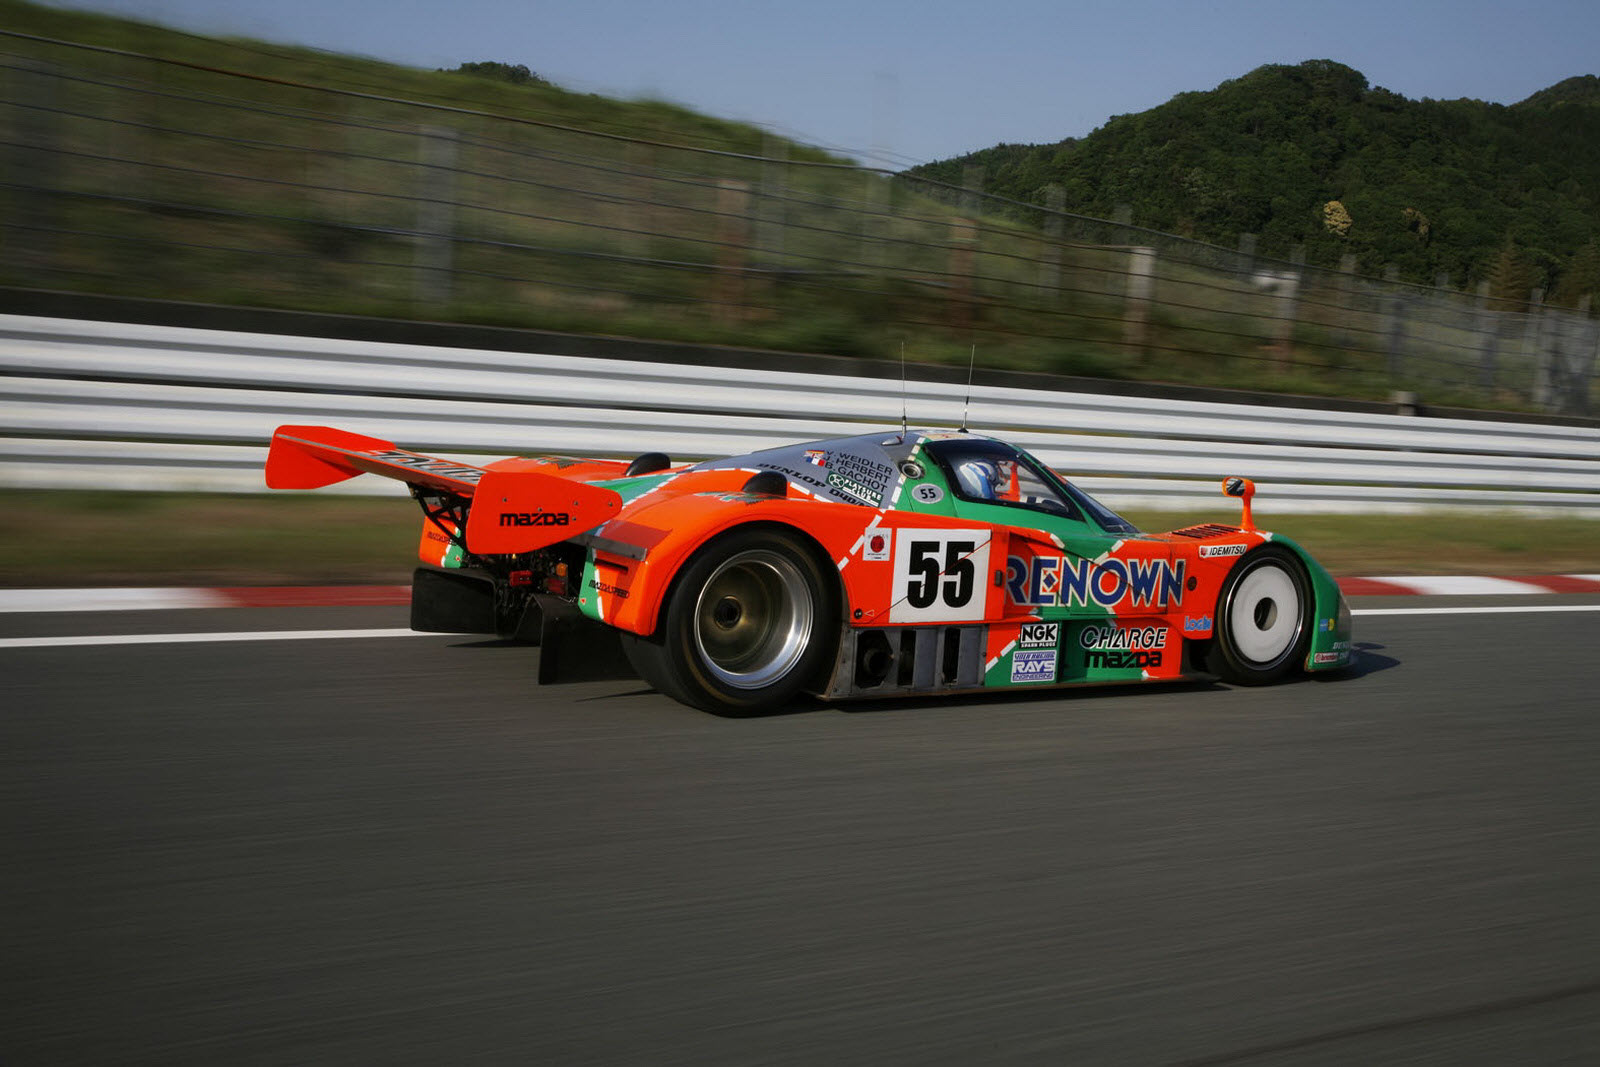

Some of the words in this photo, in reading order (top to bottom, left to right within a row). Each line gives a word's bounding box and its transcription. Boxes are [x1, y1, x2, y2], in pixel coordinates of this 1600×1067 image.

[835, 459, 892, 484] HERBERT
[839, 453, 893, 475] WEIDLER
[756, 463, 827, 488] DUNLOP
[837, 466, 888, 493] GACHOT
[920, 487, 936, 500] 55
[499, 512, 569, 526] mazda
[1208, 545, 1248, 556] IDEMITSU
[907, 541, 976, 609] 55
[1005, 556, 1187, 607] RENOWN
[1021, 624, 1057, 642] NGK
[1080, 627, 1168, 650] CHARGE
[1013, 660, 1054, 673] RAYS
[1085, 651, 1162, 669] mazda
